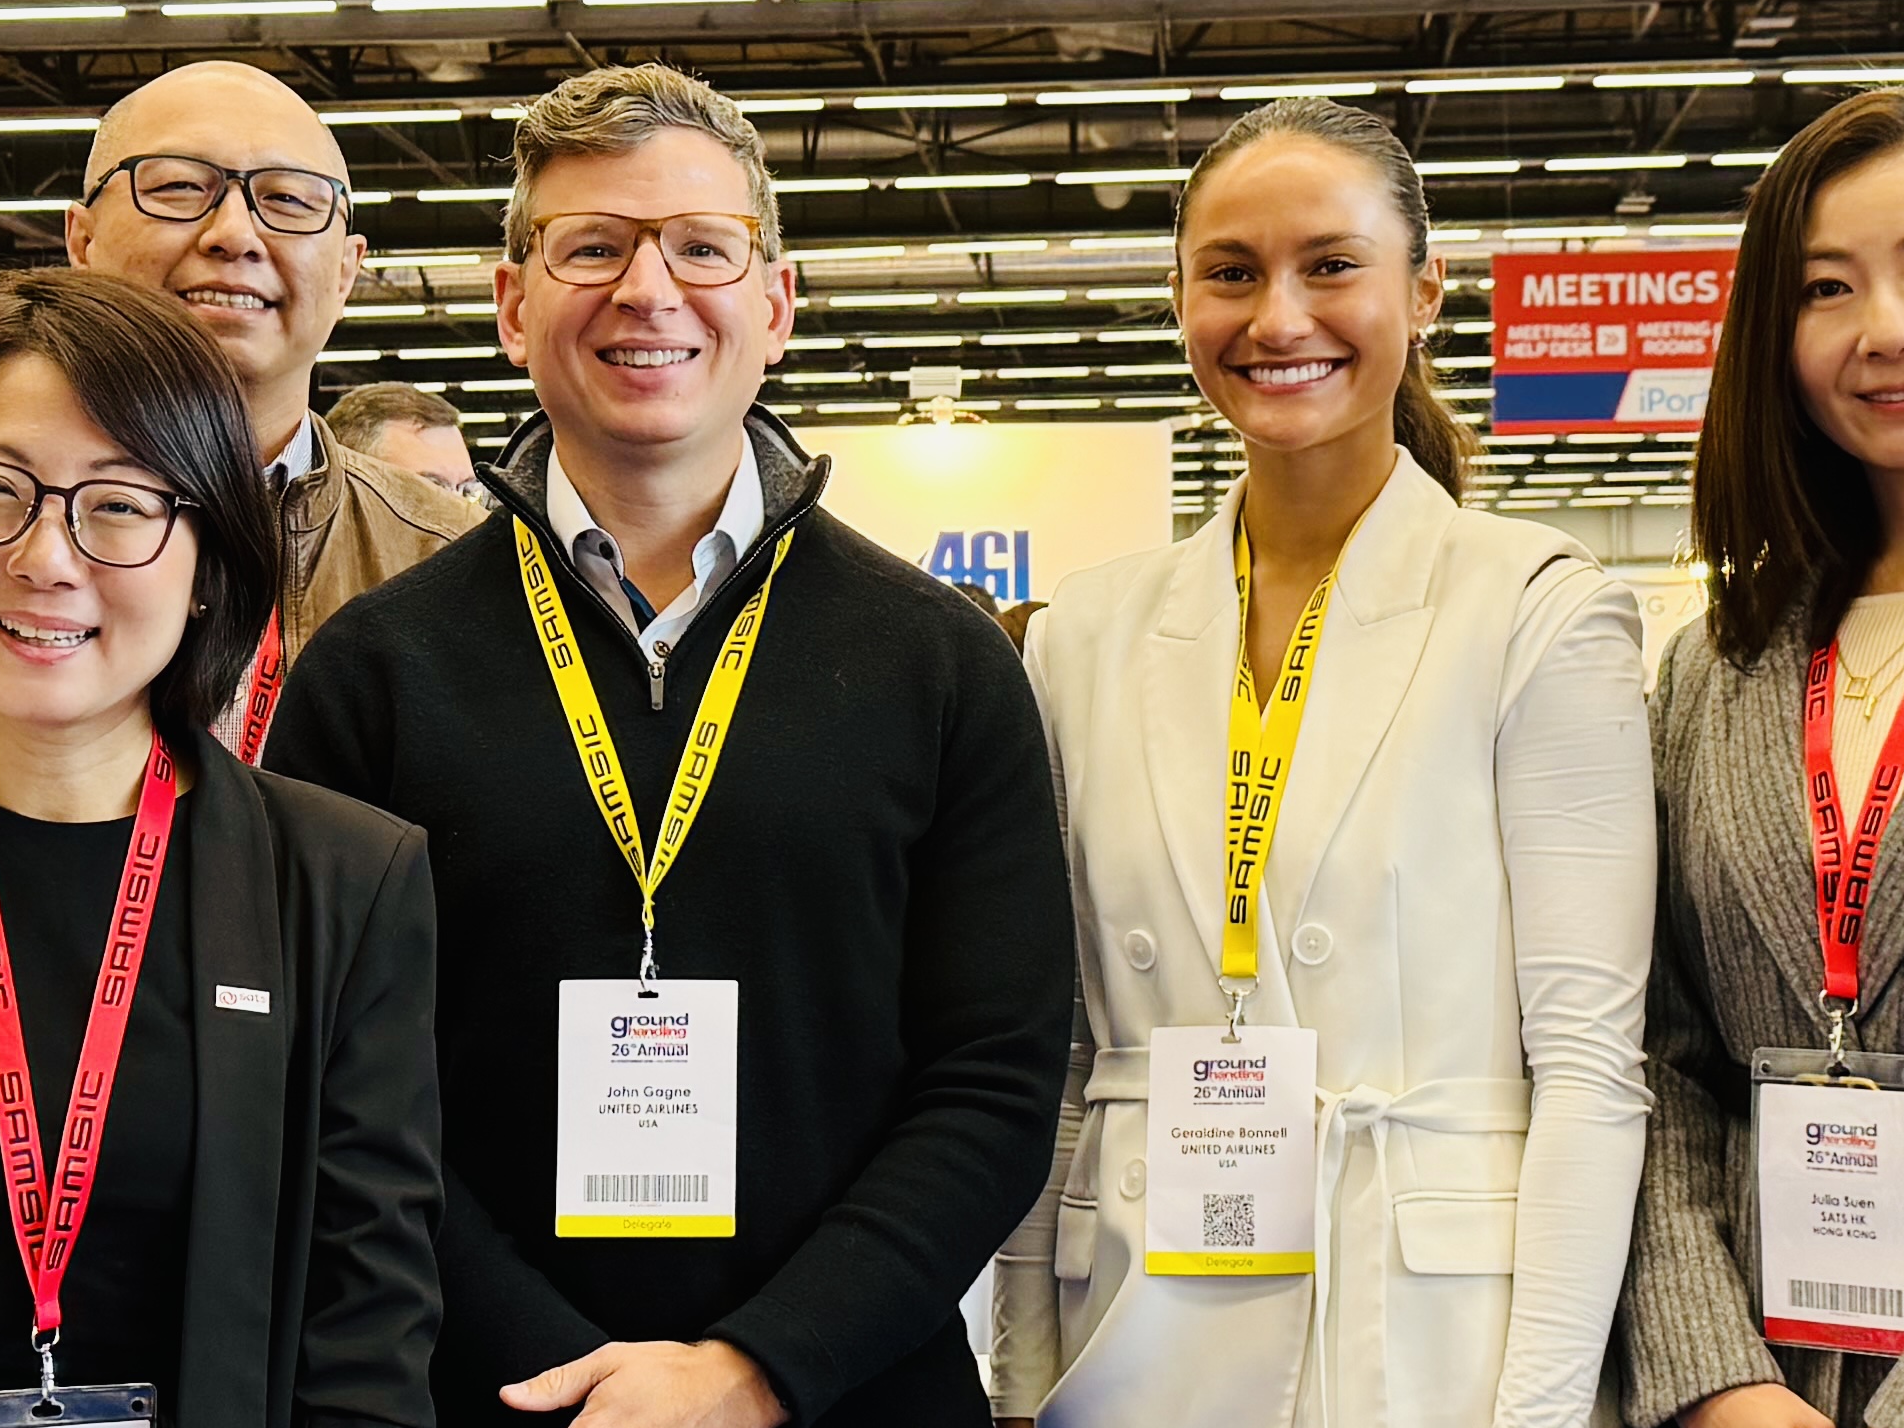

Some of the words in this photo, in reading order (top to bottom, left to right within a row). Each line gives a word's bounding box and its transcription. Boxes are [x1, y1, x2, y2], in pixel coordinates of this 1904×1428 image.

[1521, 270, 1720, 308] MEETINGS
[520, 532, 573, 670] SAMSIC
[721, 585, 765, 671] MSIC
[242, 654, 280, 764] MSIC
[575, 713, 643, 877] SAMSIC
[652, 720, 718, 883] SAMSIC
[1229, 756, 1281, 925] SAMSIC
[1838, 764, 1898, 946] SAMSIC
[102, 831, 161, 1007] SAMSIC
[610, 1013, 689, 1039] ground
[606, 1086, 639, 1098] John
[643, 1086, 691, 1100] Gagne
[1193, 1055, 1266, 1081] ground
[599, 1104, 641, 1114] UNITED
[646, 1104, 698, 1114] AIRLINES
[638, 1119, 658, 1128] USA
[1171, 1127, 1235, 1139] Geraldine
[1806, 1122, 1878, 1146] ground
[46, 1069, 104, 1271] SAMSIC
[1181, 1144, 1222, 1155] UNITED
[1225, 1144, 1276, 1155] AIRLINES
